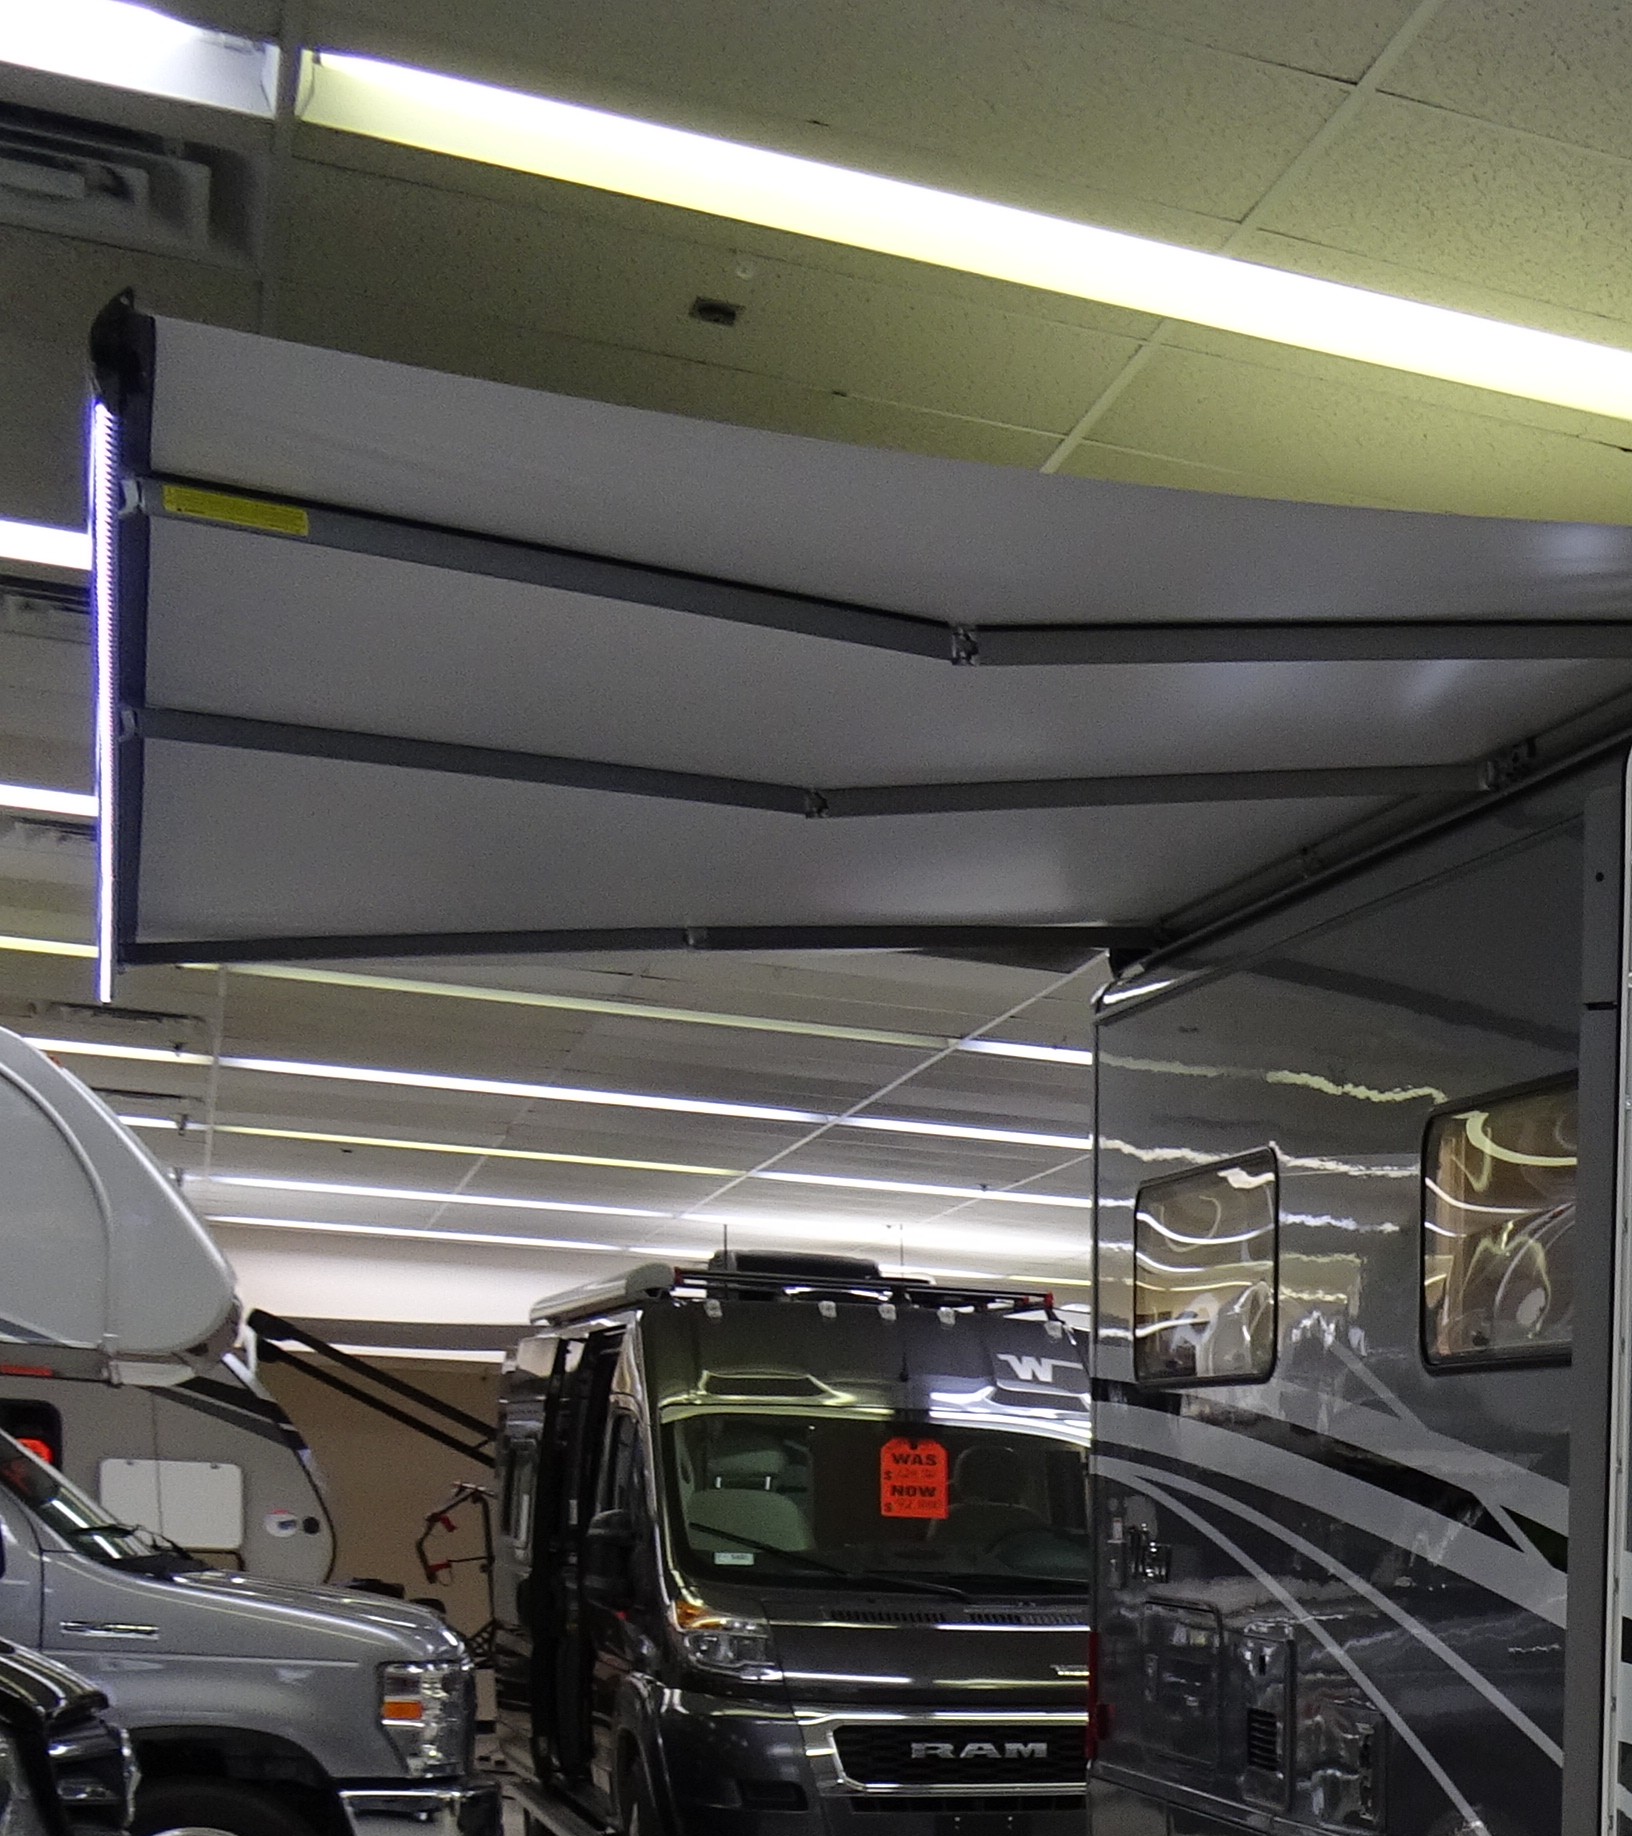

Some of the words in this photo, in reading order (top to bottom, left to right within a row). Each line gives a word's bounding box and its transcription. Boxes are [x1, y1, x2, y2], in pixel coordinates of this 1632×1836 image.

[996, 1353, 1083, 1382] W
[892, 1453, 937, 1466] WAS
[891, 1485, 936, 1497] NOW
[911, 1742, 1048, 1759] RAM
